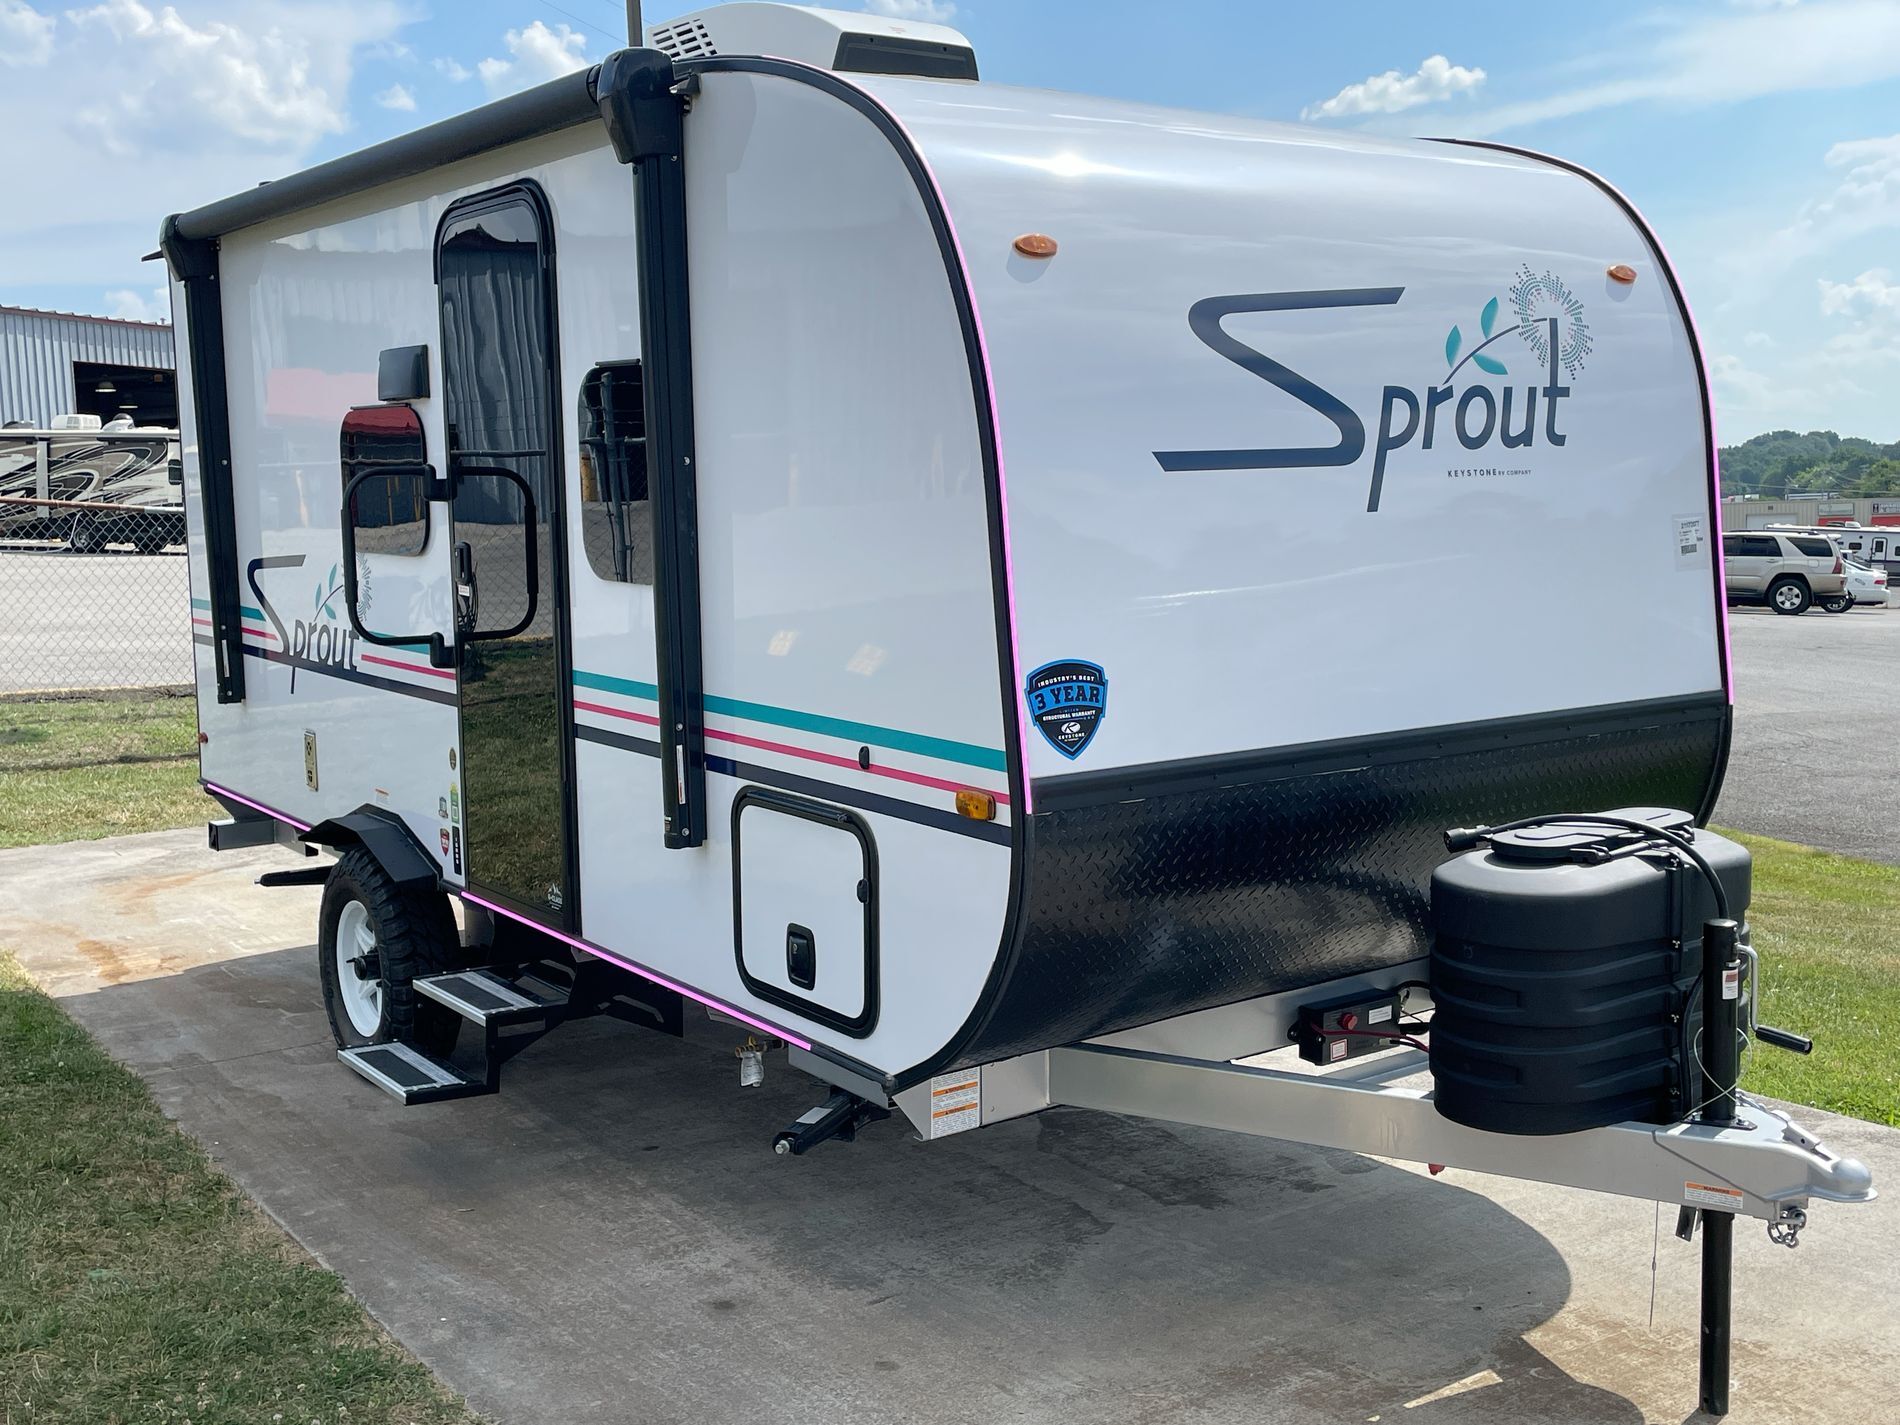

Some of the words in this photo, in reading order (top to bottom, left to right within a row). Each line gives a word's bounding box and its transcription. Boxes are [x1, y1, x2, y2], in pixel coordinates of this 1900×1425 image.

[1152, 287, 1570, 512] Sprout
[1447, 468, 1497, 477] KEYSTONE
[247, 554, 360, 694] Sprout
[1037, 675, 1077, 688] INDUSTRY'S
[1034, 693, 1047, 710] 3
[1050, 685, 1100, 704] YEAR
[1071, 710, 1096, 718] WARRANTY
[1058, 732, 1085, 740] KEYSTONE
